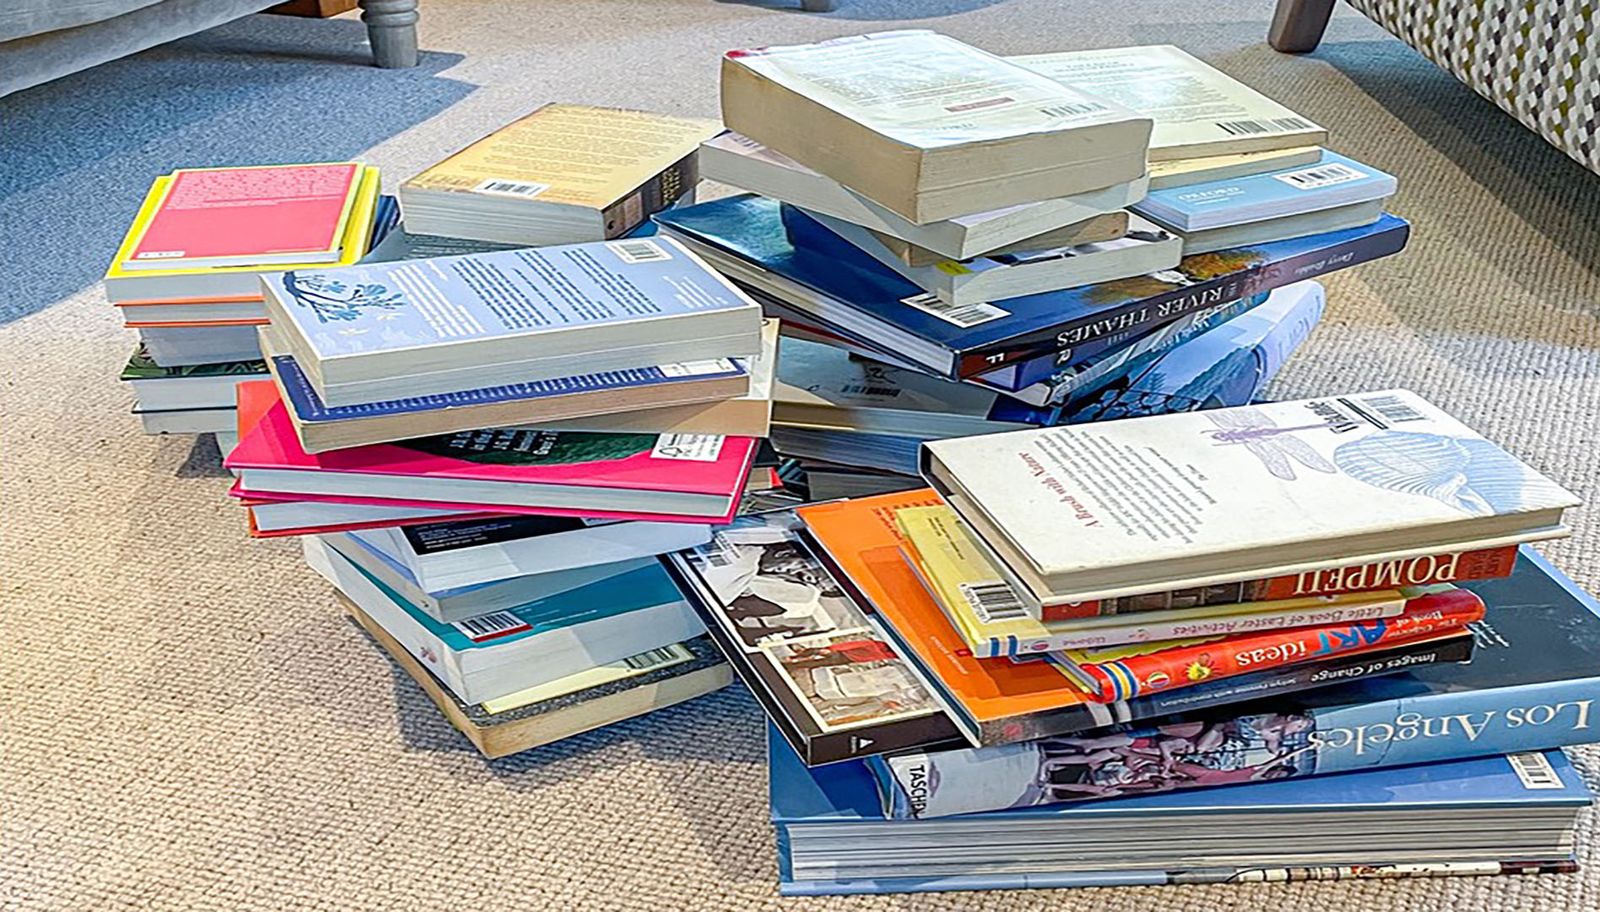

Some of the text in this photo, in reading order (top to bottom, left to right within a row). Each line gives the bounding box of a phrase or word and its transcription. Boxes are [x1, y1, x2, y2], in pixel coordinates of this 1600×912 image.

[1157, 283, 1225, 317] RIVER
[1056, 308, 1151, 347] THAMES
[1292, 552, 1464, 595] POMPEII
[1171, 607, 1384, 636] Little Book of Easter Activities
[1234, 619, 1388, 667] ART ideas
[1310, 652, 1436, 683] Images of Change
[1307, 699, 1595, 756] Los Angeles
